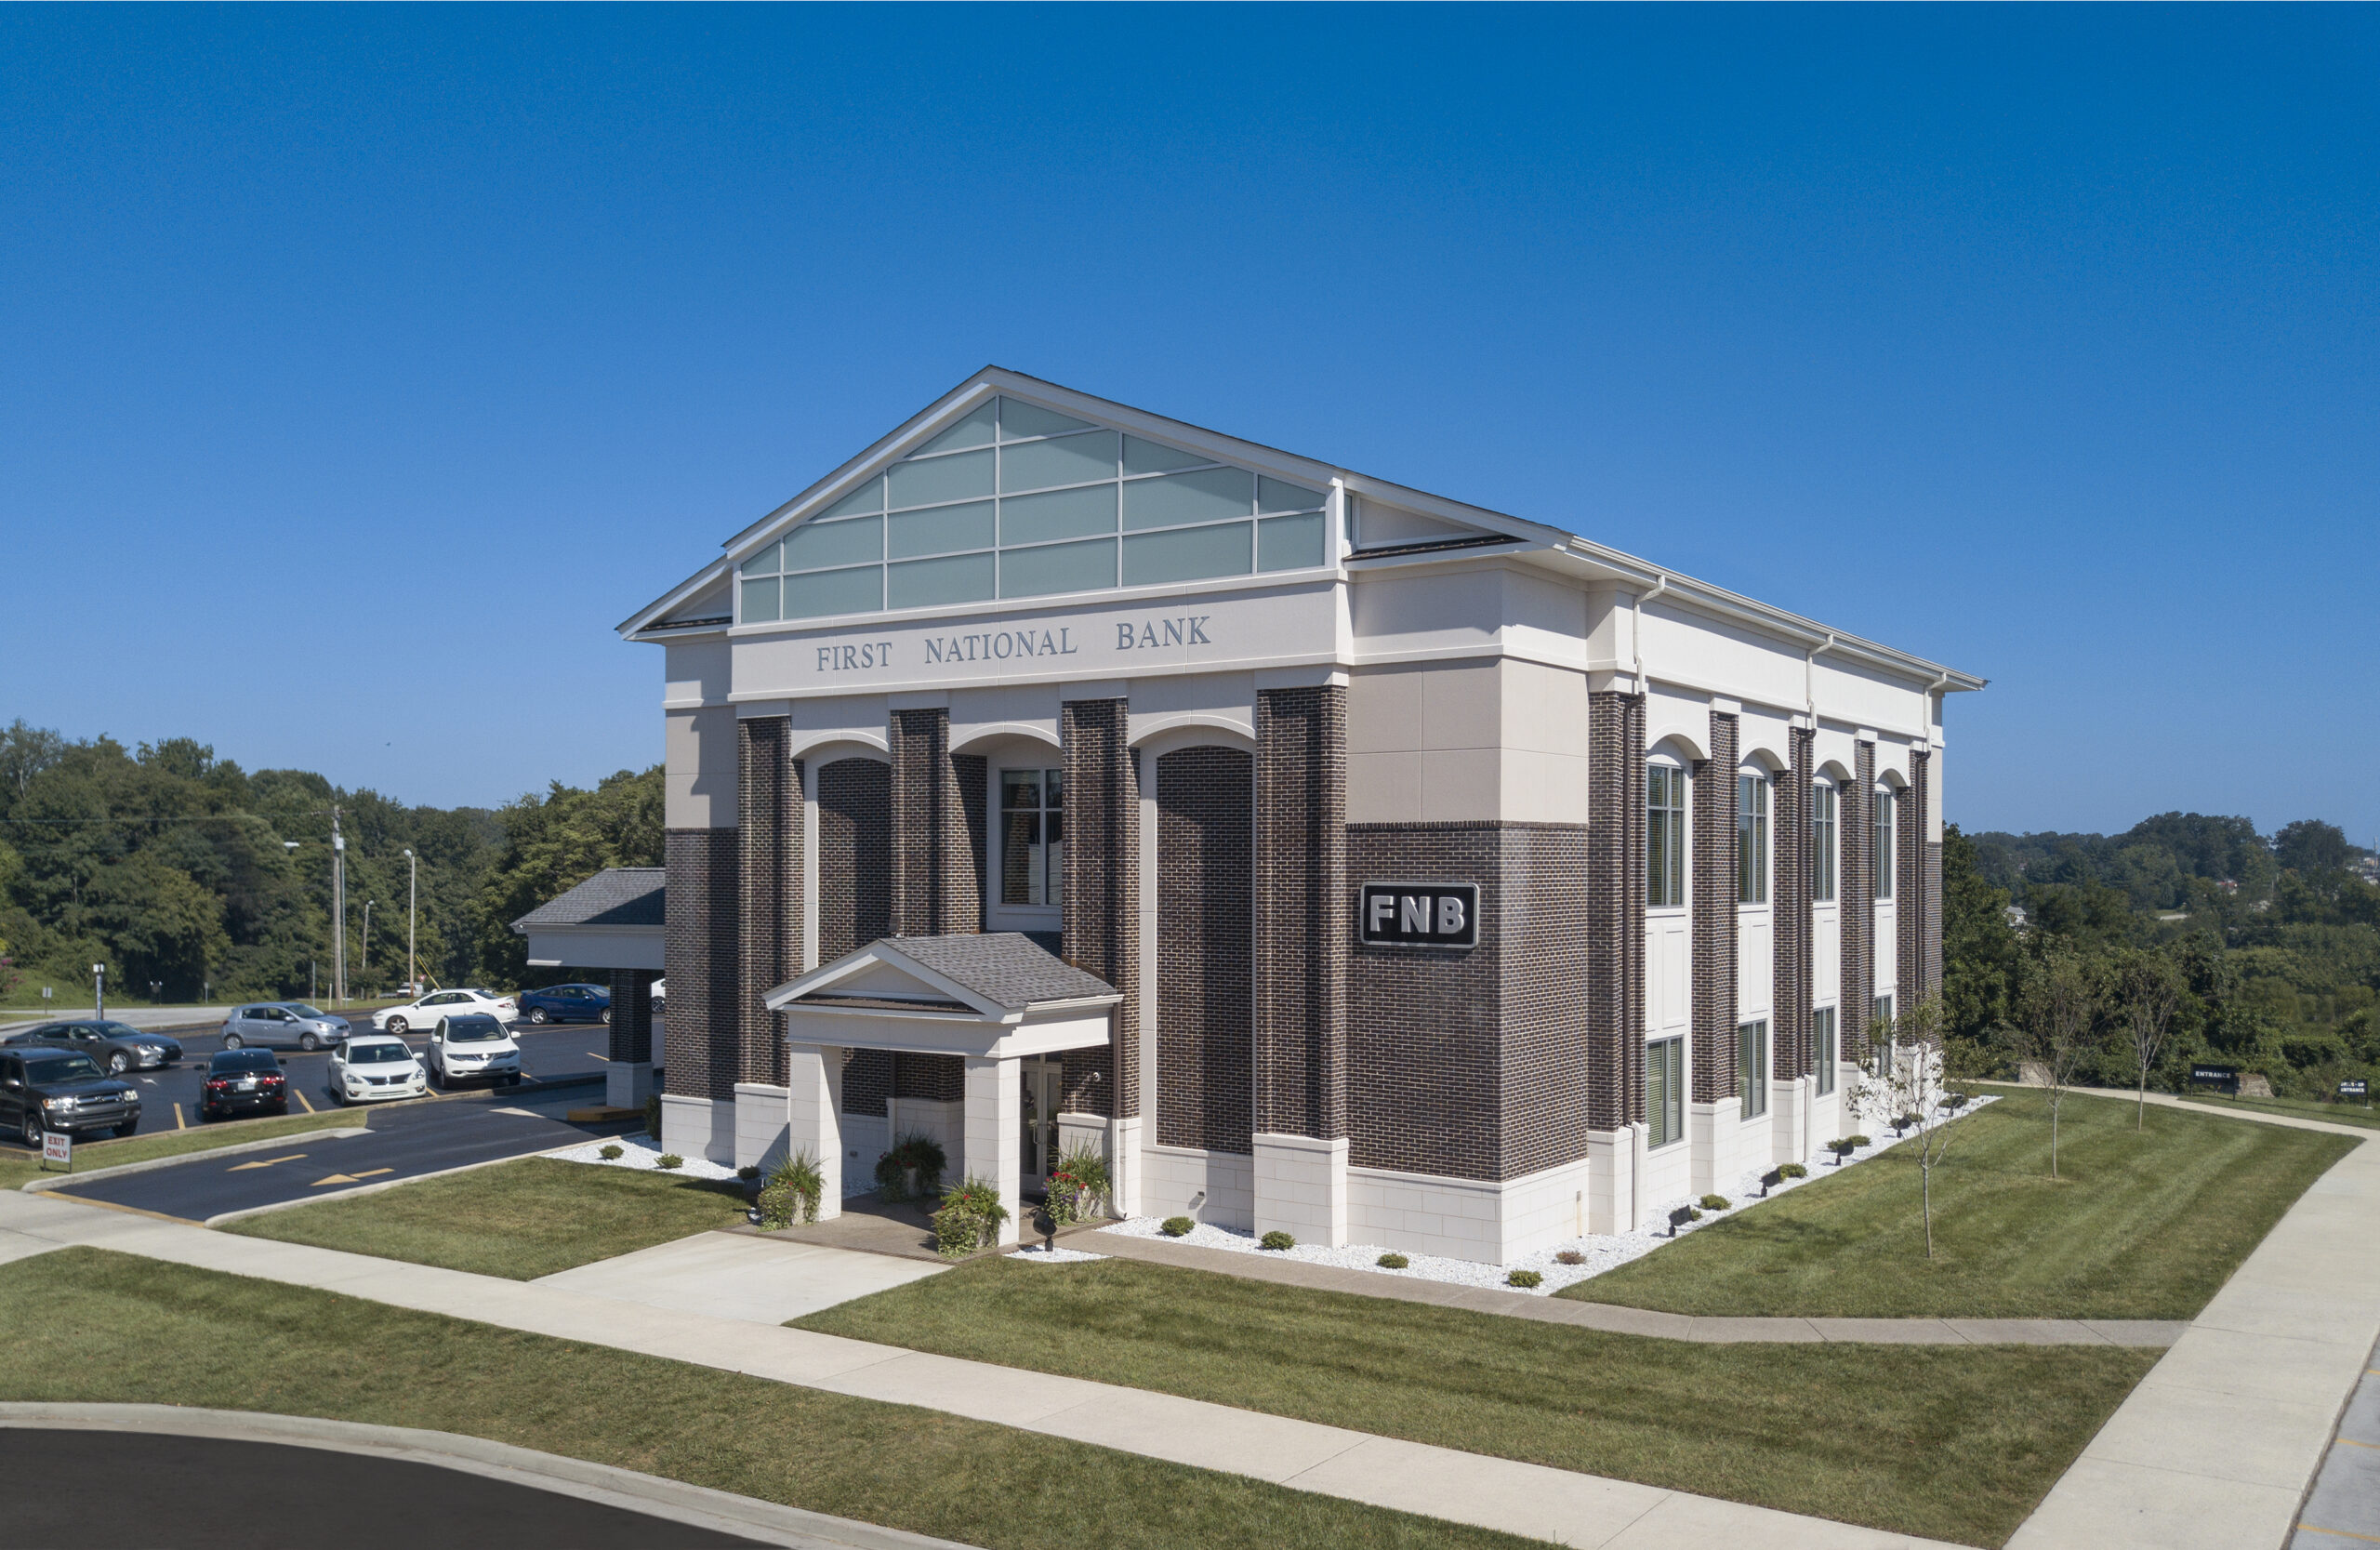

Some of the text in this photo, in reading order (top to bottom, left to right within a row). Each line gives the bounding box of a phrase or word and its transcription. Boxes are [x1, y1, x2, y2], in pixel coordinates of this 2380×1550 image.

[816, 616, 1211, 671] FIRST NATIONAL BANK
[1369, 894, 1465, 934] FNB
[2195, 1070, 2230, 1079] ENTRANCE
[47, 1135, 65, 1146] EXIT
[46, 1147, 67, 1159] ONLY
